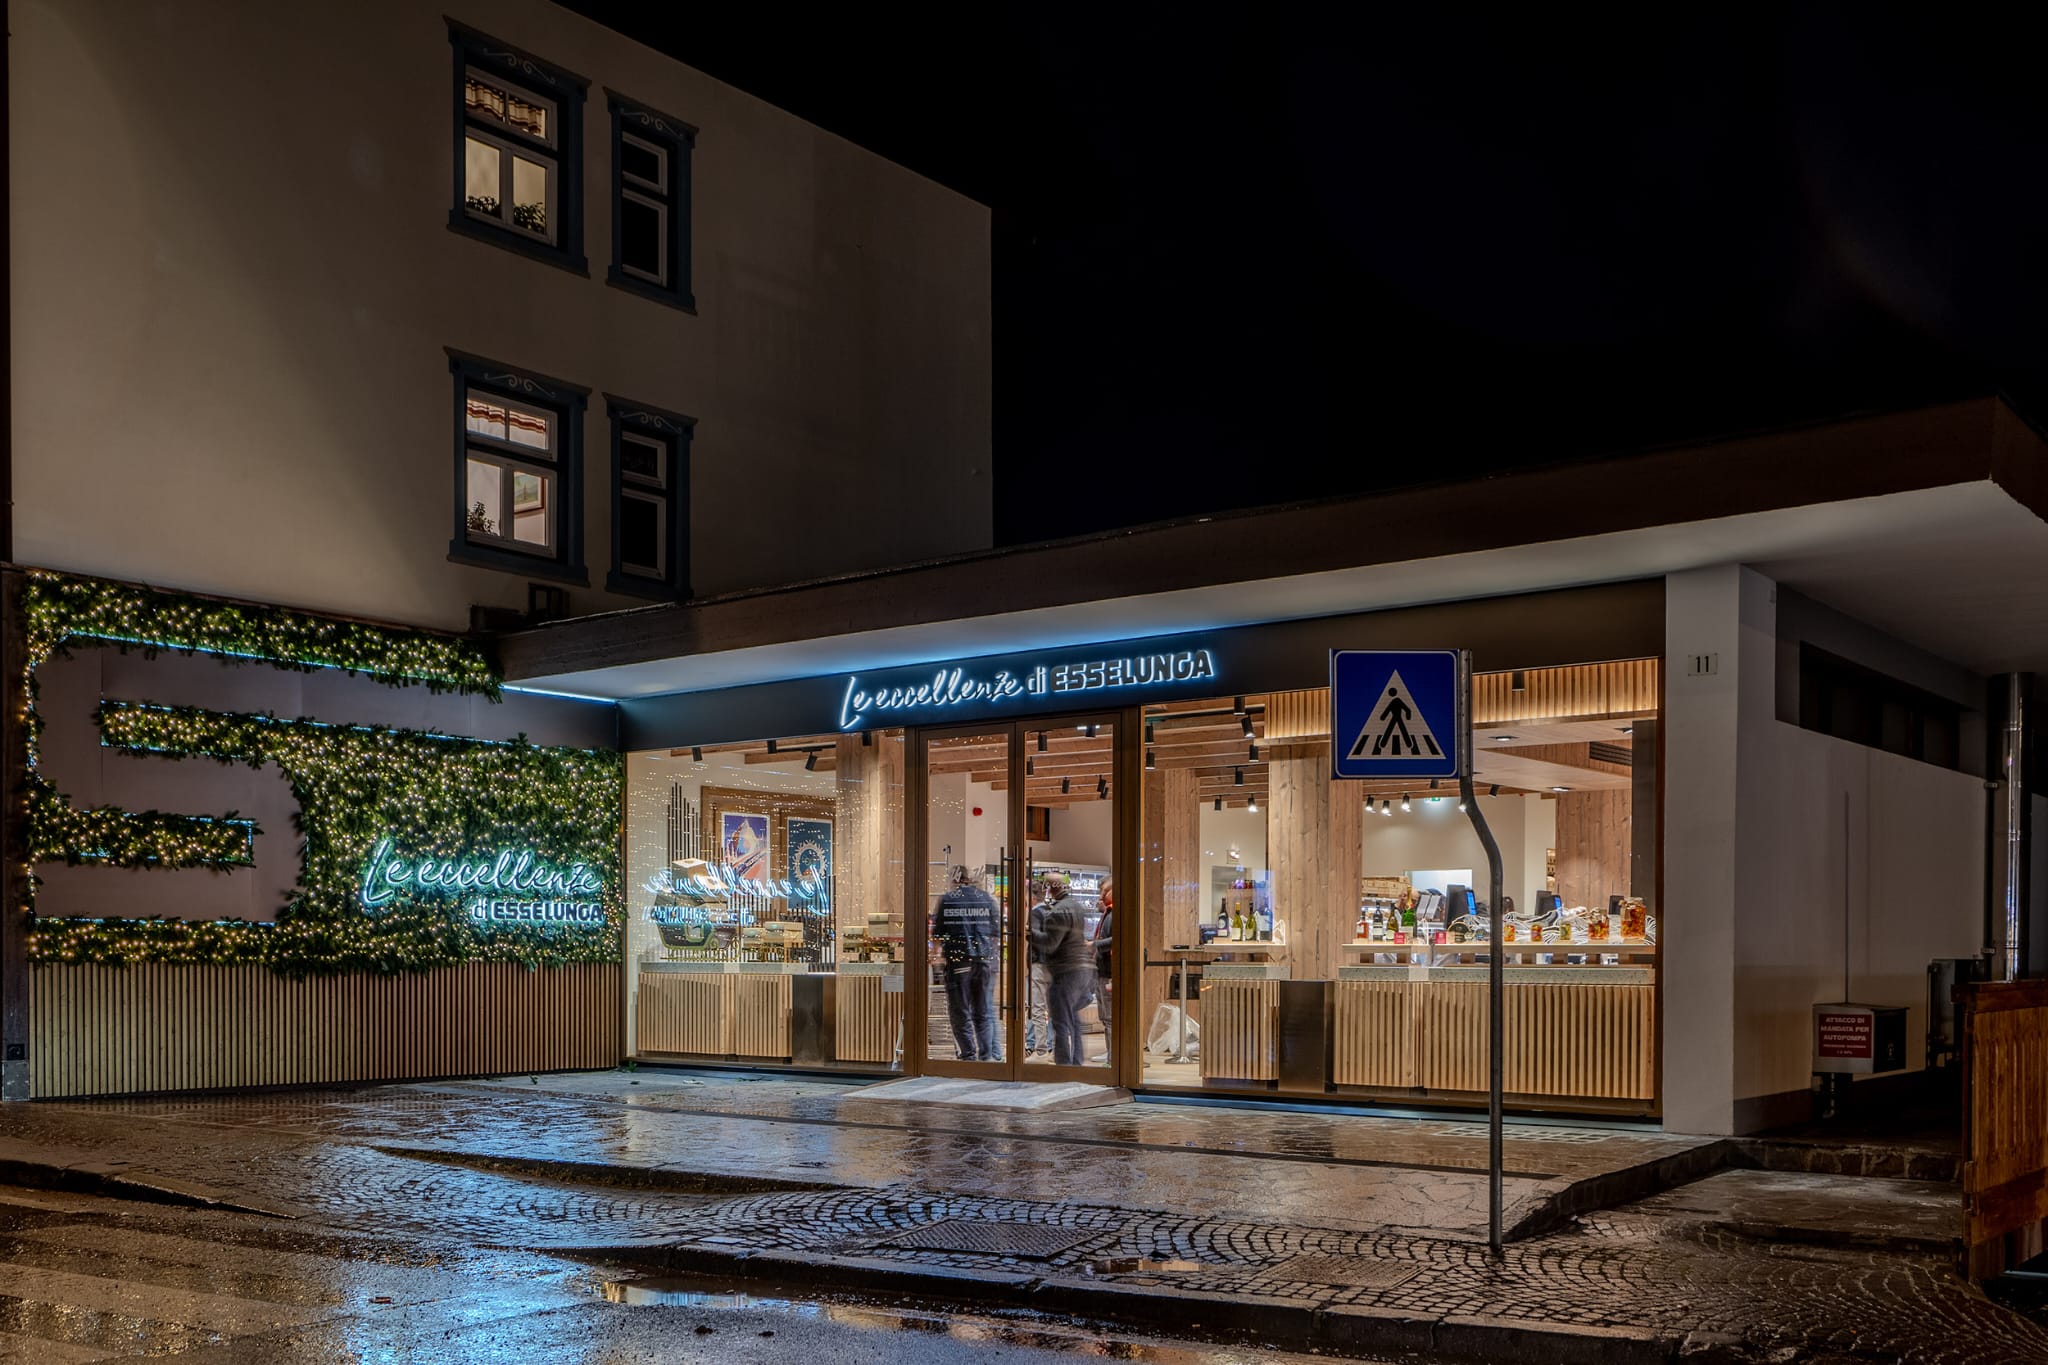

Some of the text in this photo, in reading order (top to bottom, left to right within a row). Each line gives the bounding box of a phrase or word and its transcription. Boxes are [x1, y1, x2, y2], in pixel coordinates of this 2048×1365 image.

[1696, 655, 1710, 673] 11
[840, 649, 1214, 728] Le eccellenze di ESSELUNGA
[364, 839, 603, 903] Le eccellenze
[471, 898, 604, 921] di ESSELUNGA
[943, 908, 990, 917] ESSELUNGA
